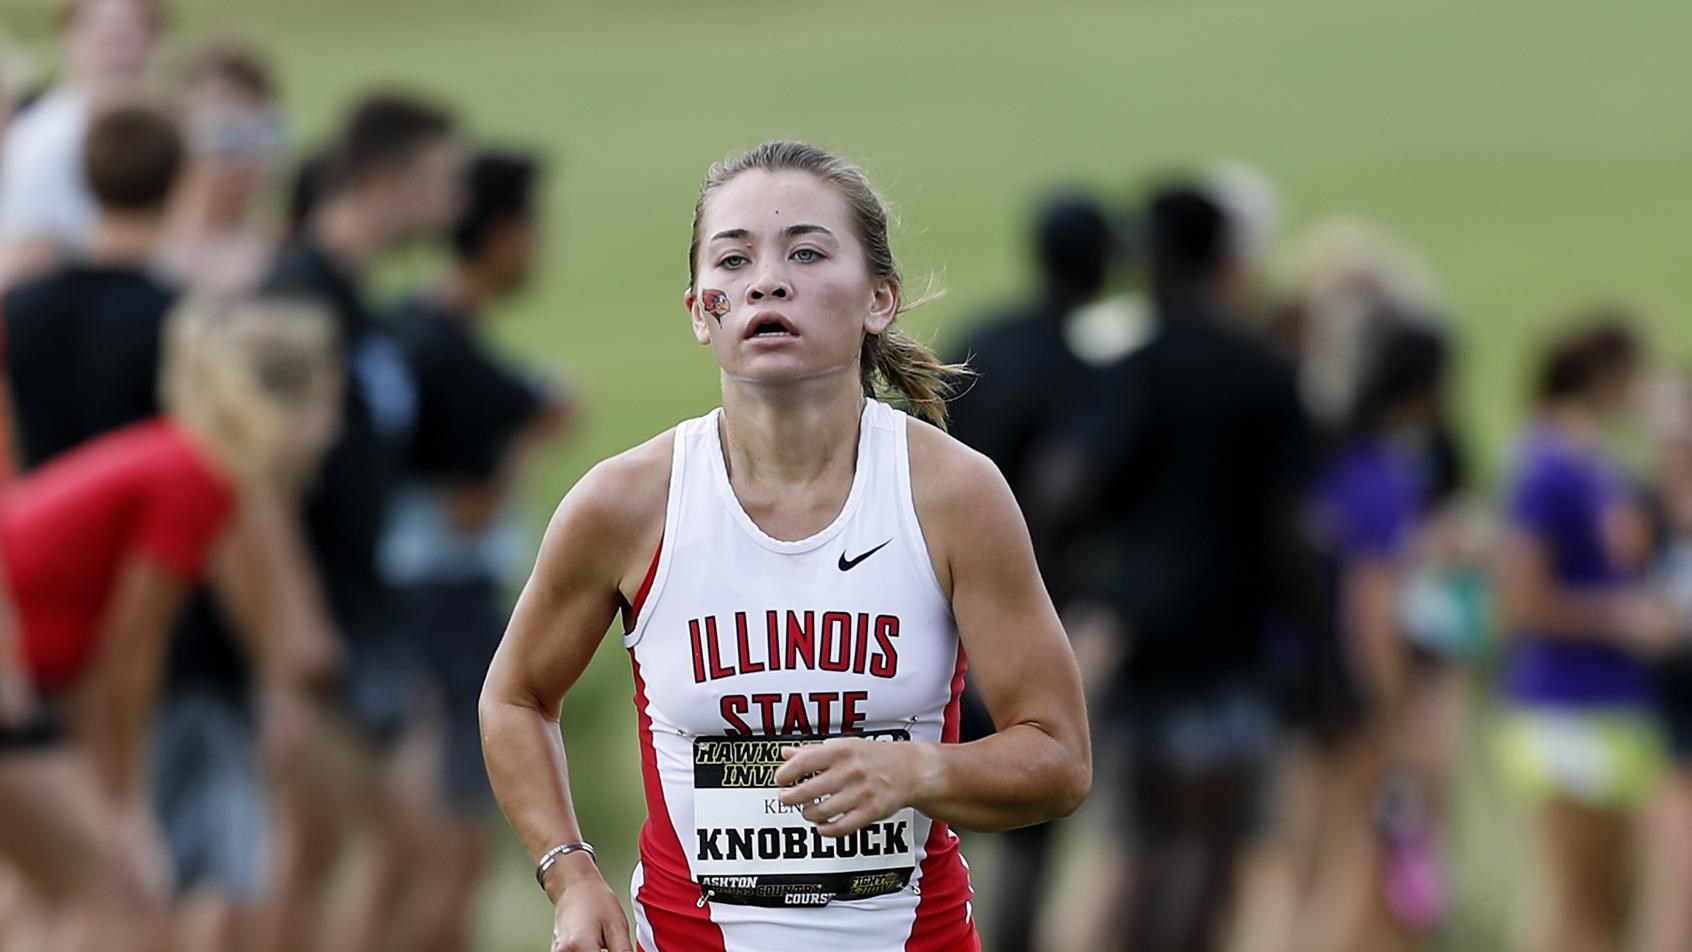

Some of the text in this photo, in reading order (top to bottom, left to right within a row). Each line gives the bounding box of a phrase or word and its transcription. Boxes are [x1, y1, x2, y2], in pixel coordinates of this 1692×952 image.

[689, 610, 900, 683] ILLINOIS
[720, 691, 868, 736] STATE
[696, 741, 824, 764] HAWKE
[698, 821, 908, 859] KNOBLOCK
[703, 877, 757, 888] ASHTON
